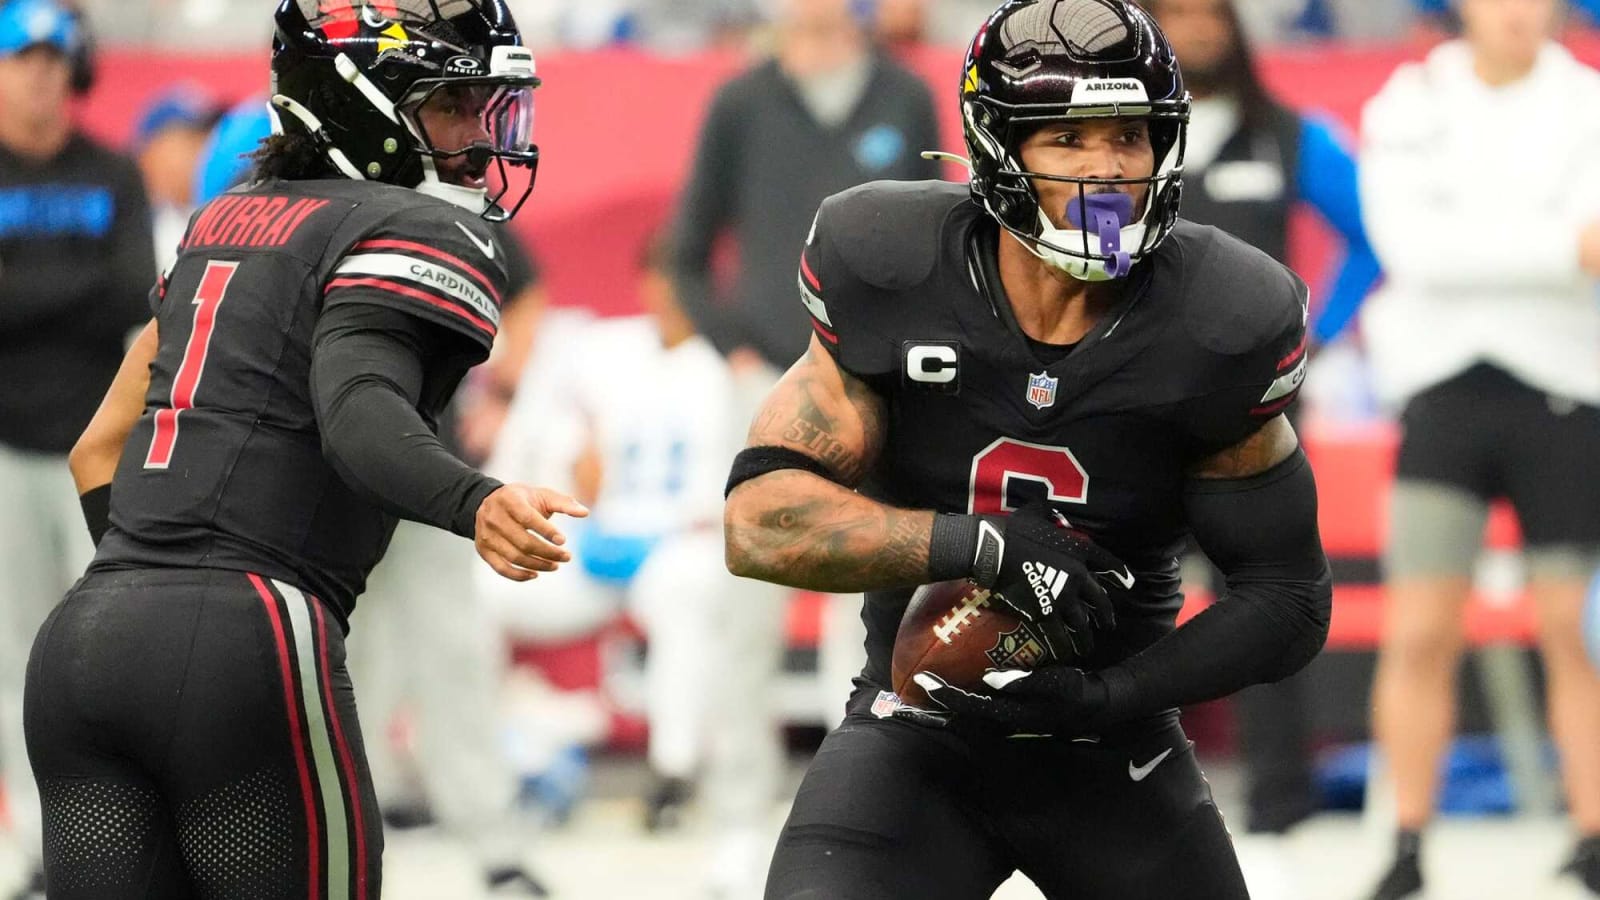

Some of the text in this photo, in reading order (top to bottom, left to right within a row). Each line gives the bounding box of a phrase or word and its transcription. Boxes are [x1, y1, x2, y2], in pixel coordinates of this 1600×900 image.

[446, 65, 484, 75] OAKLEY
[1085, 82, 1139, 91] ARIZONA
[180, 194, 331, 249] MURRAY
[409, 263, 498, 320] CARDINALS
[143, 259, 240, 469] 1
[907, 345, 957, 383] C
[1031, 386, 1052, 403] NFL
[1022, 561, 1053, 616] adidas
